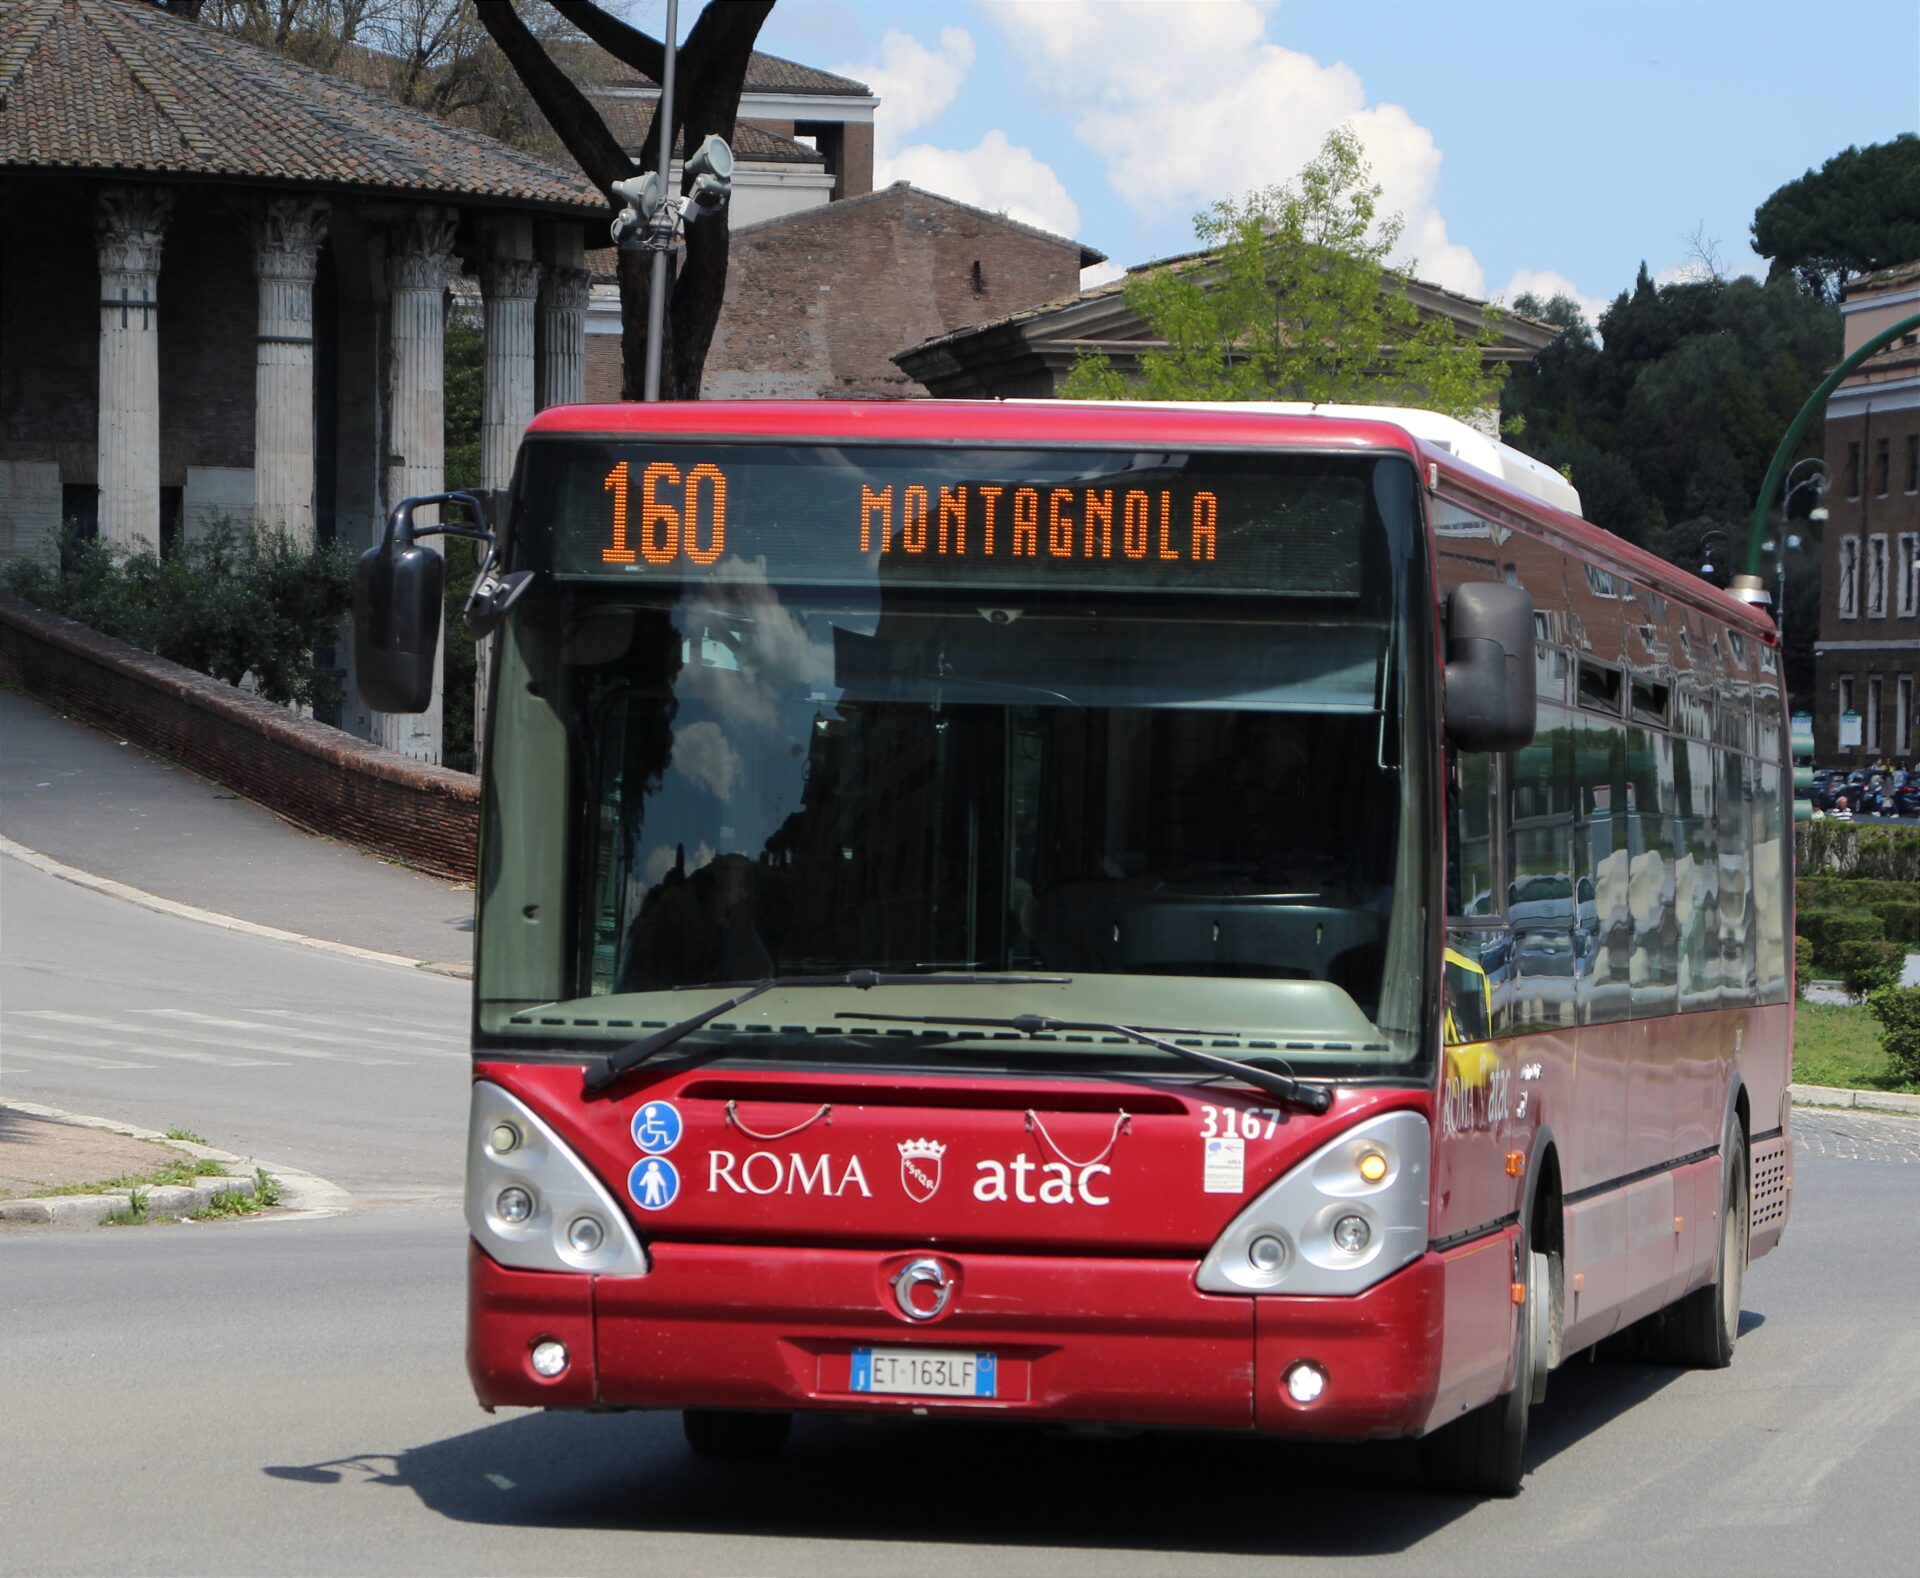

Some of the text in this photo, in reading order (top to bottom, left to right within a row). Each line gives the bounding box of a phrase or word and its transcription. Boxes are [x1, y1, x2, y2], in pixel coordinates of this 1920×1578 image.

[602, 461, 1217, 565] 160 MONTAGNOLA
[1200, 1105, 1281, 1140] 3167
[707, 1150, 873, 1198] ROMA
[972, 1153, 1112, 1206] atac
